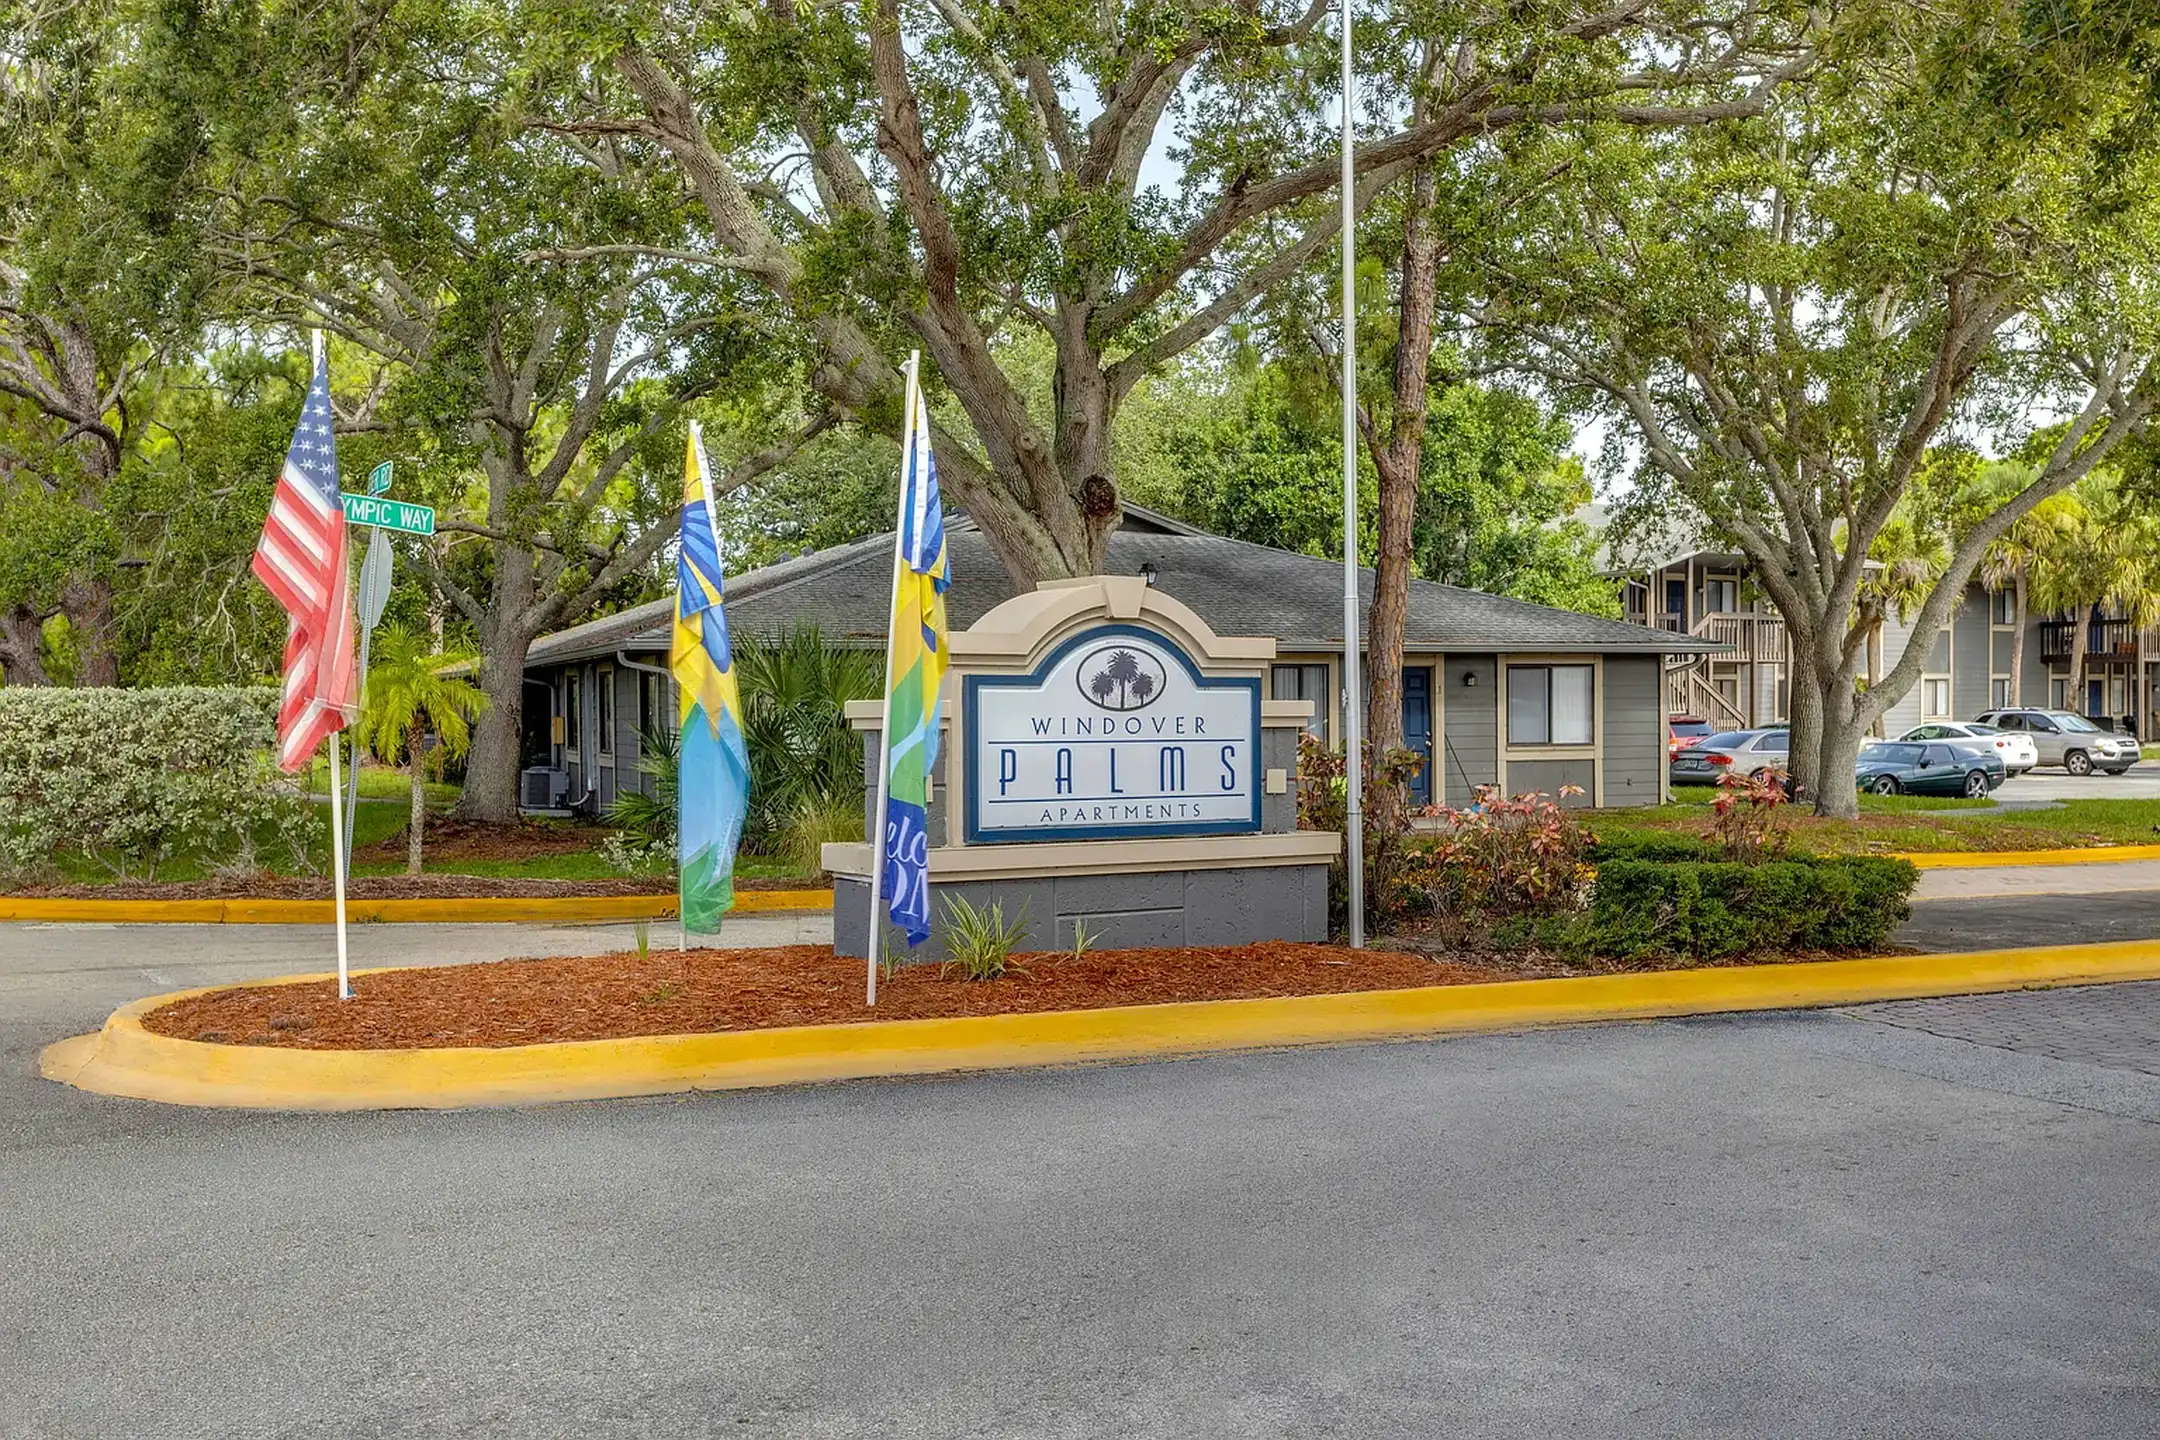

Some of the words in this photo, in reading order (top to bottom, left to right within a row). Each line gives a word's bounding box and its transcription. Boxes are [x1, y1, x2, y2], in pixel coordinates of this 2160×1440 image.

[400, 506, 431, 531] WAY
[1031, 716, 1207, 735] WINDOVER
[999, 745, 1236, 796] PALMS
[1040, 803, 1201, 822] APARTMENTS
